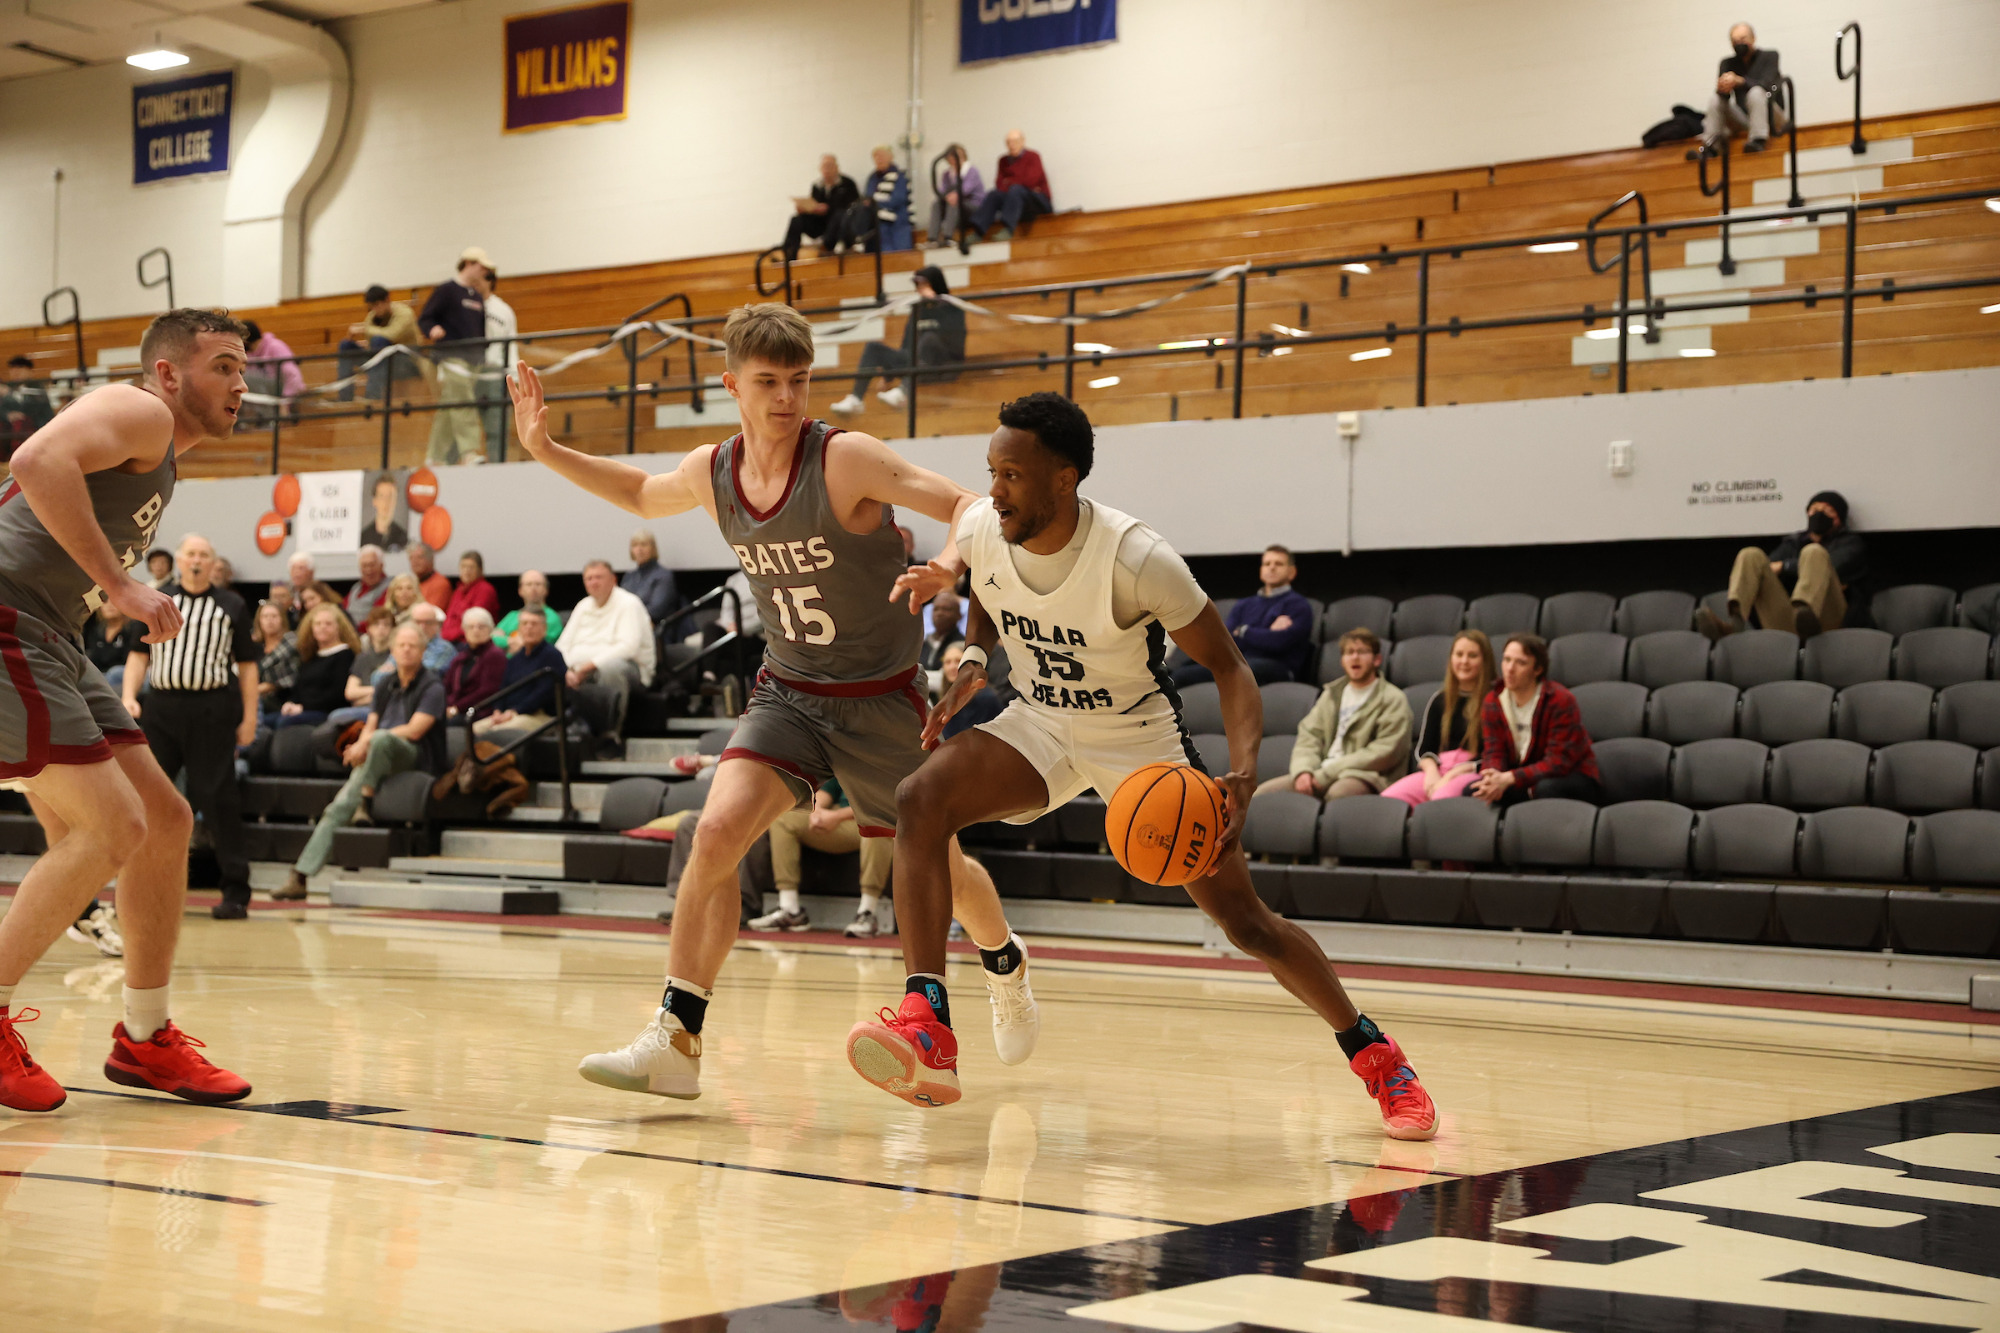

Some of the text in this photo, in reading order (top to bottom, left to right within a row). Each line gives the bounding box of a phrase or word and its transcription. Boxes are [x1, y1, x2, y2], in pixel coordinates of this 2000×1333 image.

[516, 37, 618, 98] WILLIAMS
[137, 84, 228, 128] CONNECTICUT
[148, 130, 213, 169] COLLEGE
[1692, 478, 1777, 493] NO CLIMBING
[732, 535, 835, 576] BATES
[771, 584, 837, 646] 15
[1001, 609, 1087, 647] POLAR
[1026, 643, 1085, 682] 15
[1031, 679, 1113, 710] BEARS
[1182, 821, 1207, 869] EVO
